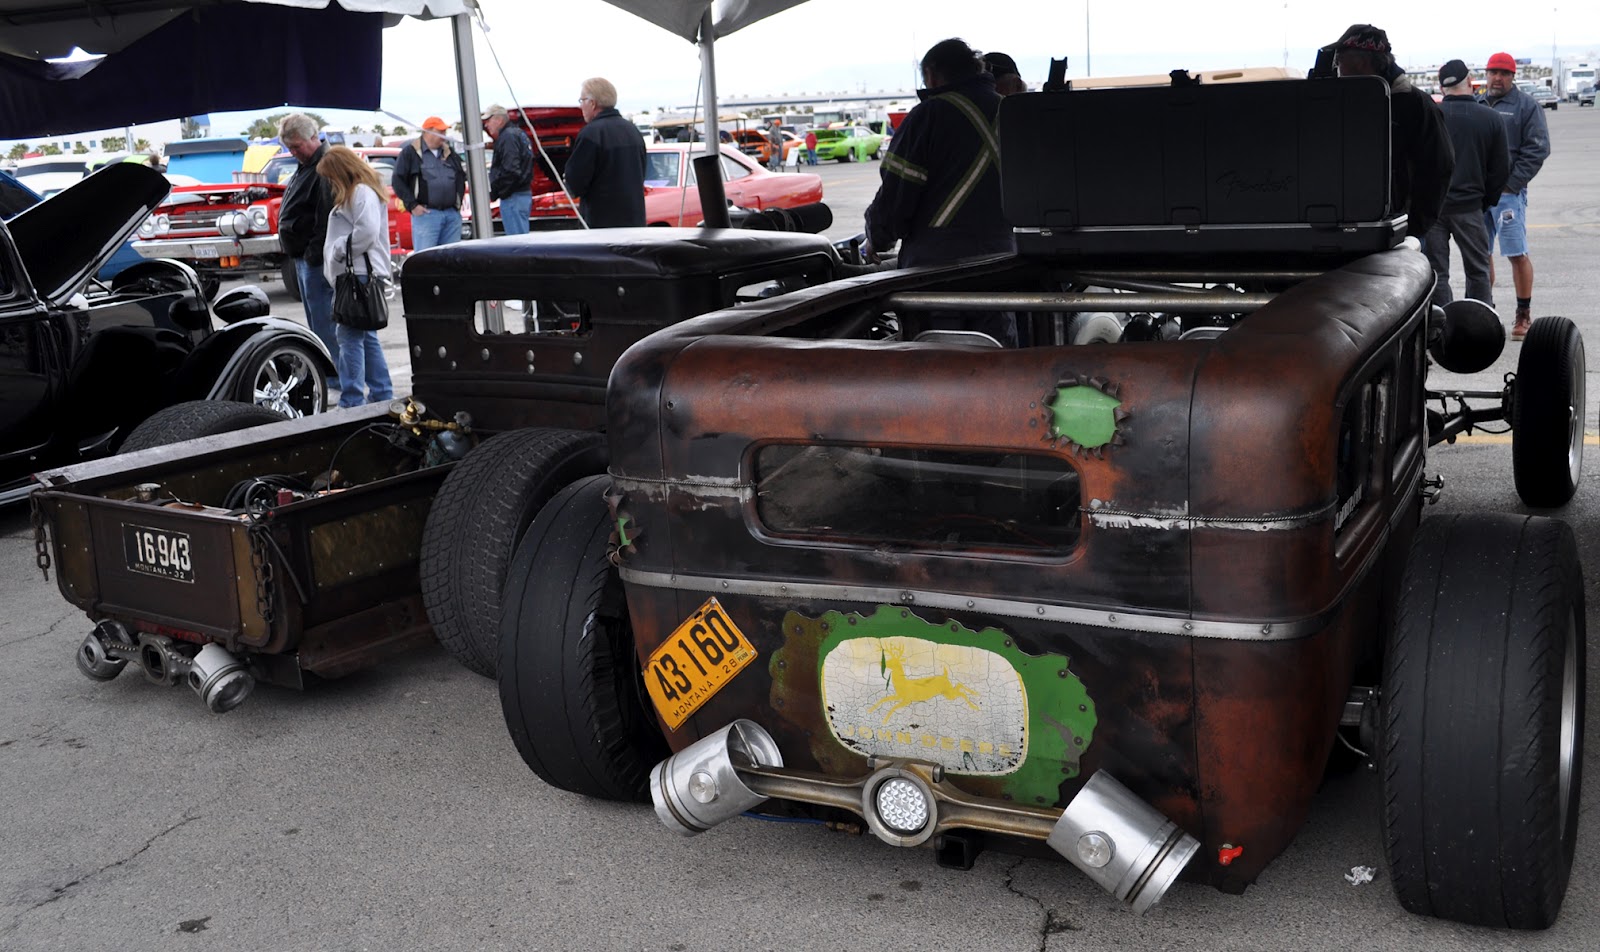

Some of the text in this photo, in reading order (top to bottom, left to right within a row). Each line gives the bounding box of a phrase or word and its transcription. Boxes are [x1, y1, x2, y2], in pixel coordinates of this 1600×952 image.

[135, 563, 167, 576] MONTANA
[673, 680, 714, 719] MONTANA
[722, 658, 738, 674] 28
[842, 724, 1012, 757] JOHN DEERE
